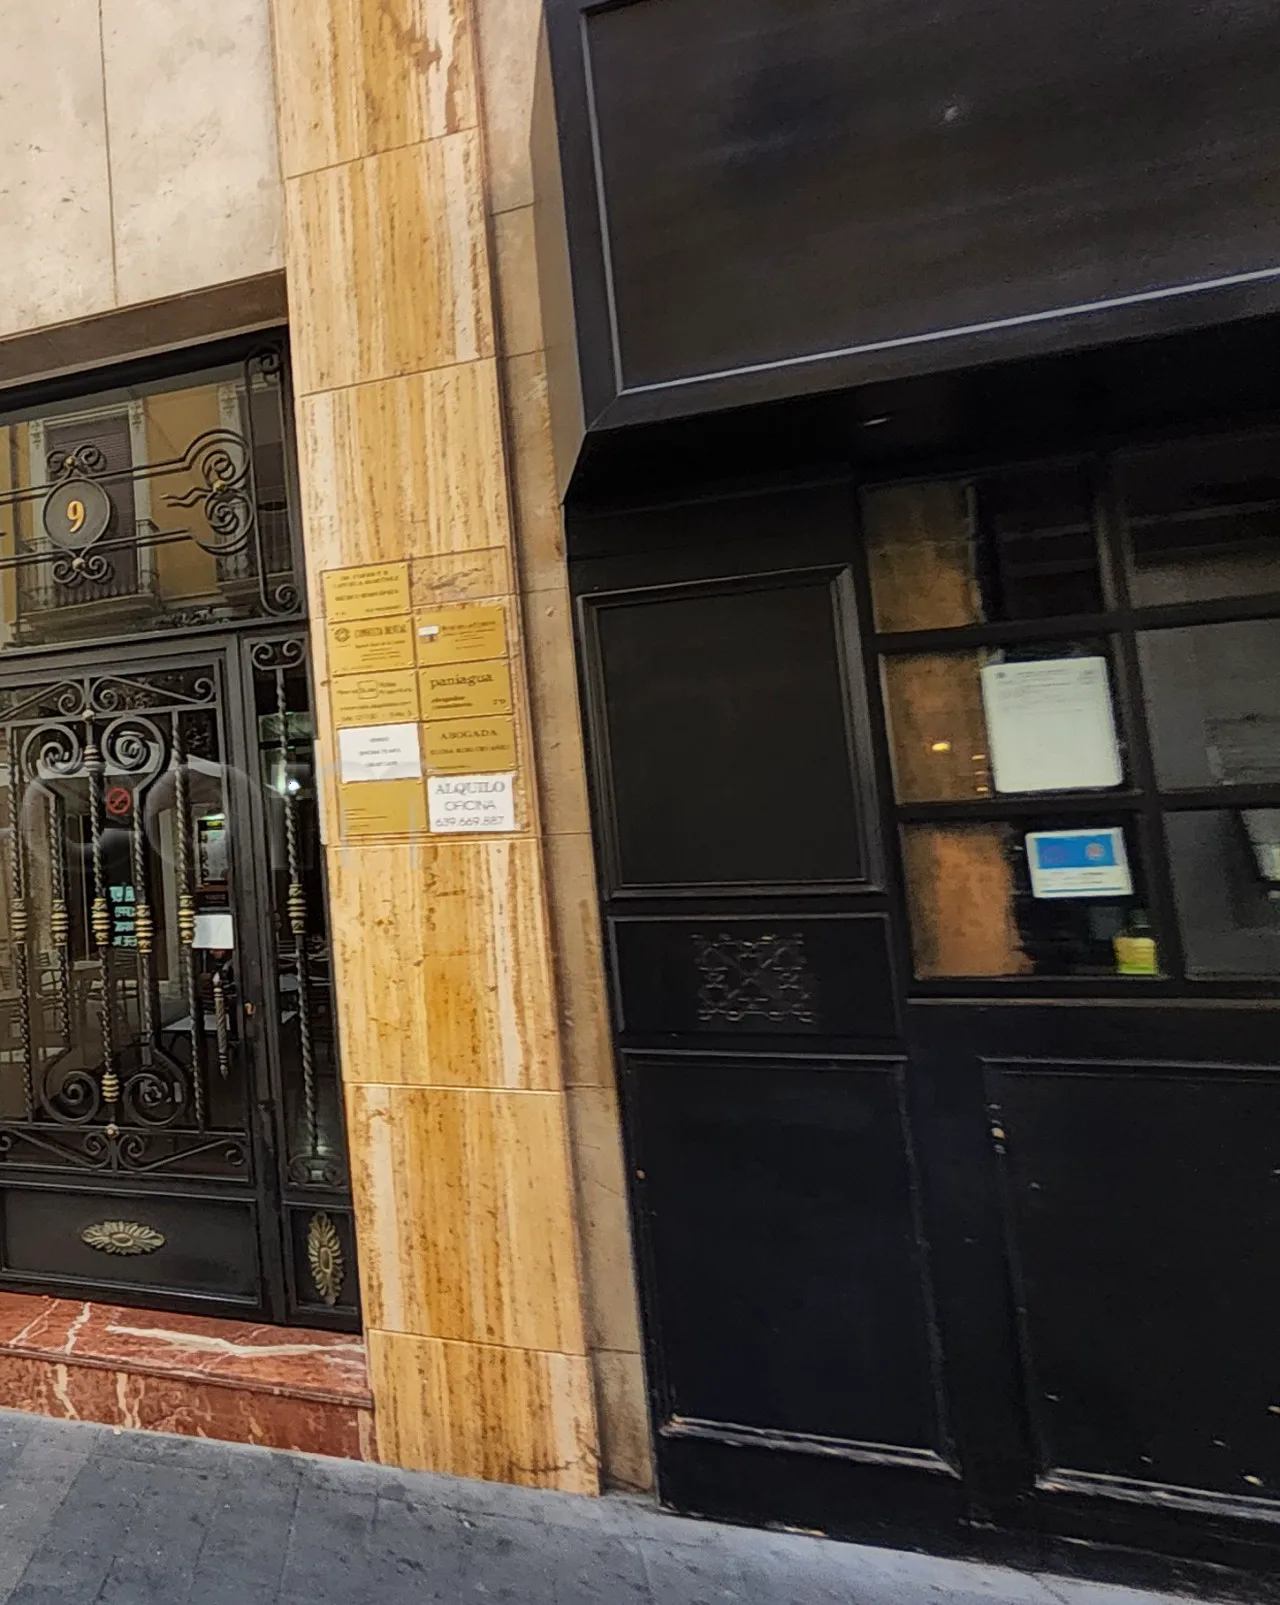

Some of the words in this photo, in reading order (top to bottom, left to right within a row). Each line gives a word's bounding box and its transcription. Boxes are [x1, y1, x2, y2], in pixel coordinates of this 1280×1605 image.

[65, 499, 85, 535] 9
[429, 673, 494, 690] paniagua
[439, 728, 499, 740] ABOGADA
[435, 780, 506, 796] ALQUILO
[444, 799, 497, 811] OFICINA
